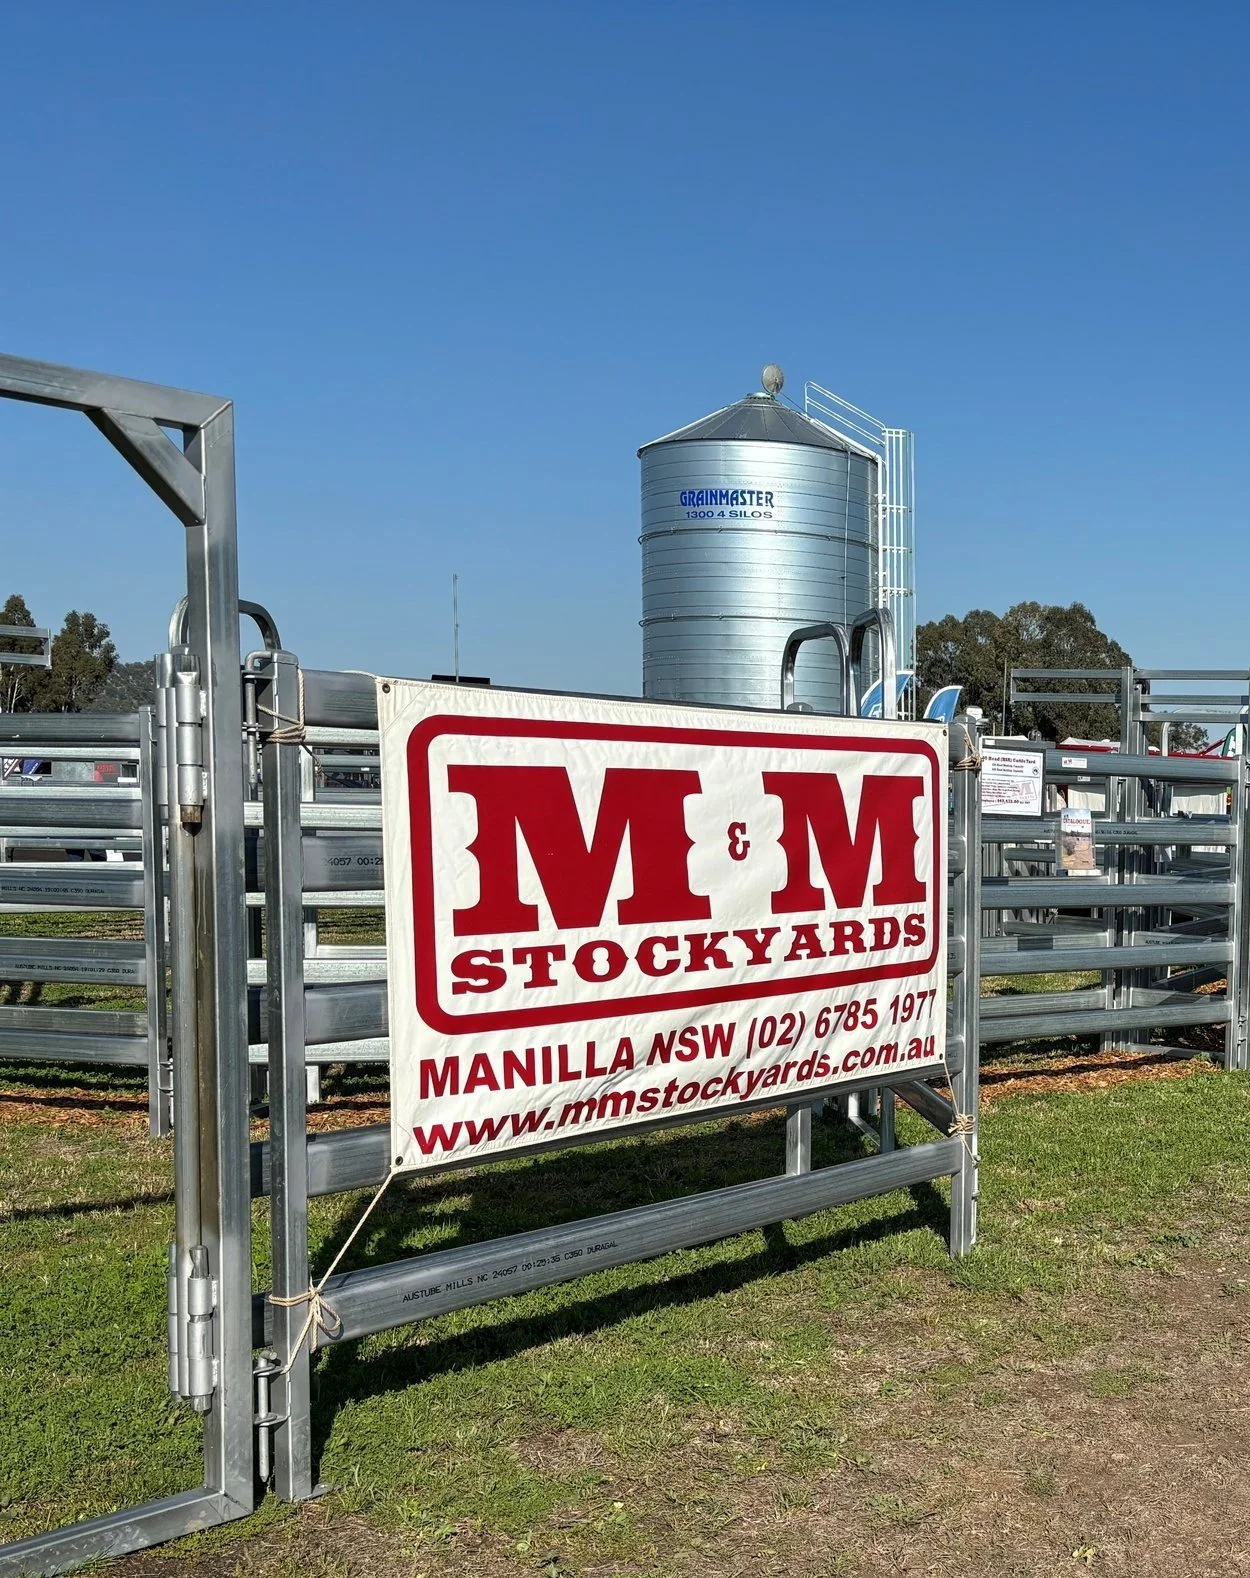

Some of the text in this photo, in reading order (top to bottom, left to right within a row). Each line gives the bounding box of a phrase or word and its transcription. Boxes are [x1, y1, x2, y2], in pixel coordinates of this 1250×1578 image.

[680, 489, 774, 508] GRAINMASTER
[686, 510, 773, 519] 1300 4 SILOS
[451, 912, 927, 995] STOCKYARDS
[419, 988, 937, 1100] MANILLA NSW (02) 6785 1977
[412, 1034, 936, 1155] www.mmstockyards.com.au
[402, 1285, 442, 1303] AUSTUBE
[445, 1277, 474, 1292] MILLS
[477, 1273, 489, 1283] NC
[492, 1265, 518, 1279] 24057
[564, 1249, 584, 1261] C350
[586, 1240, 618, 1257] DURAGAL
